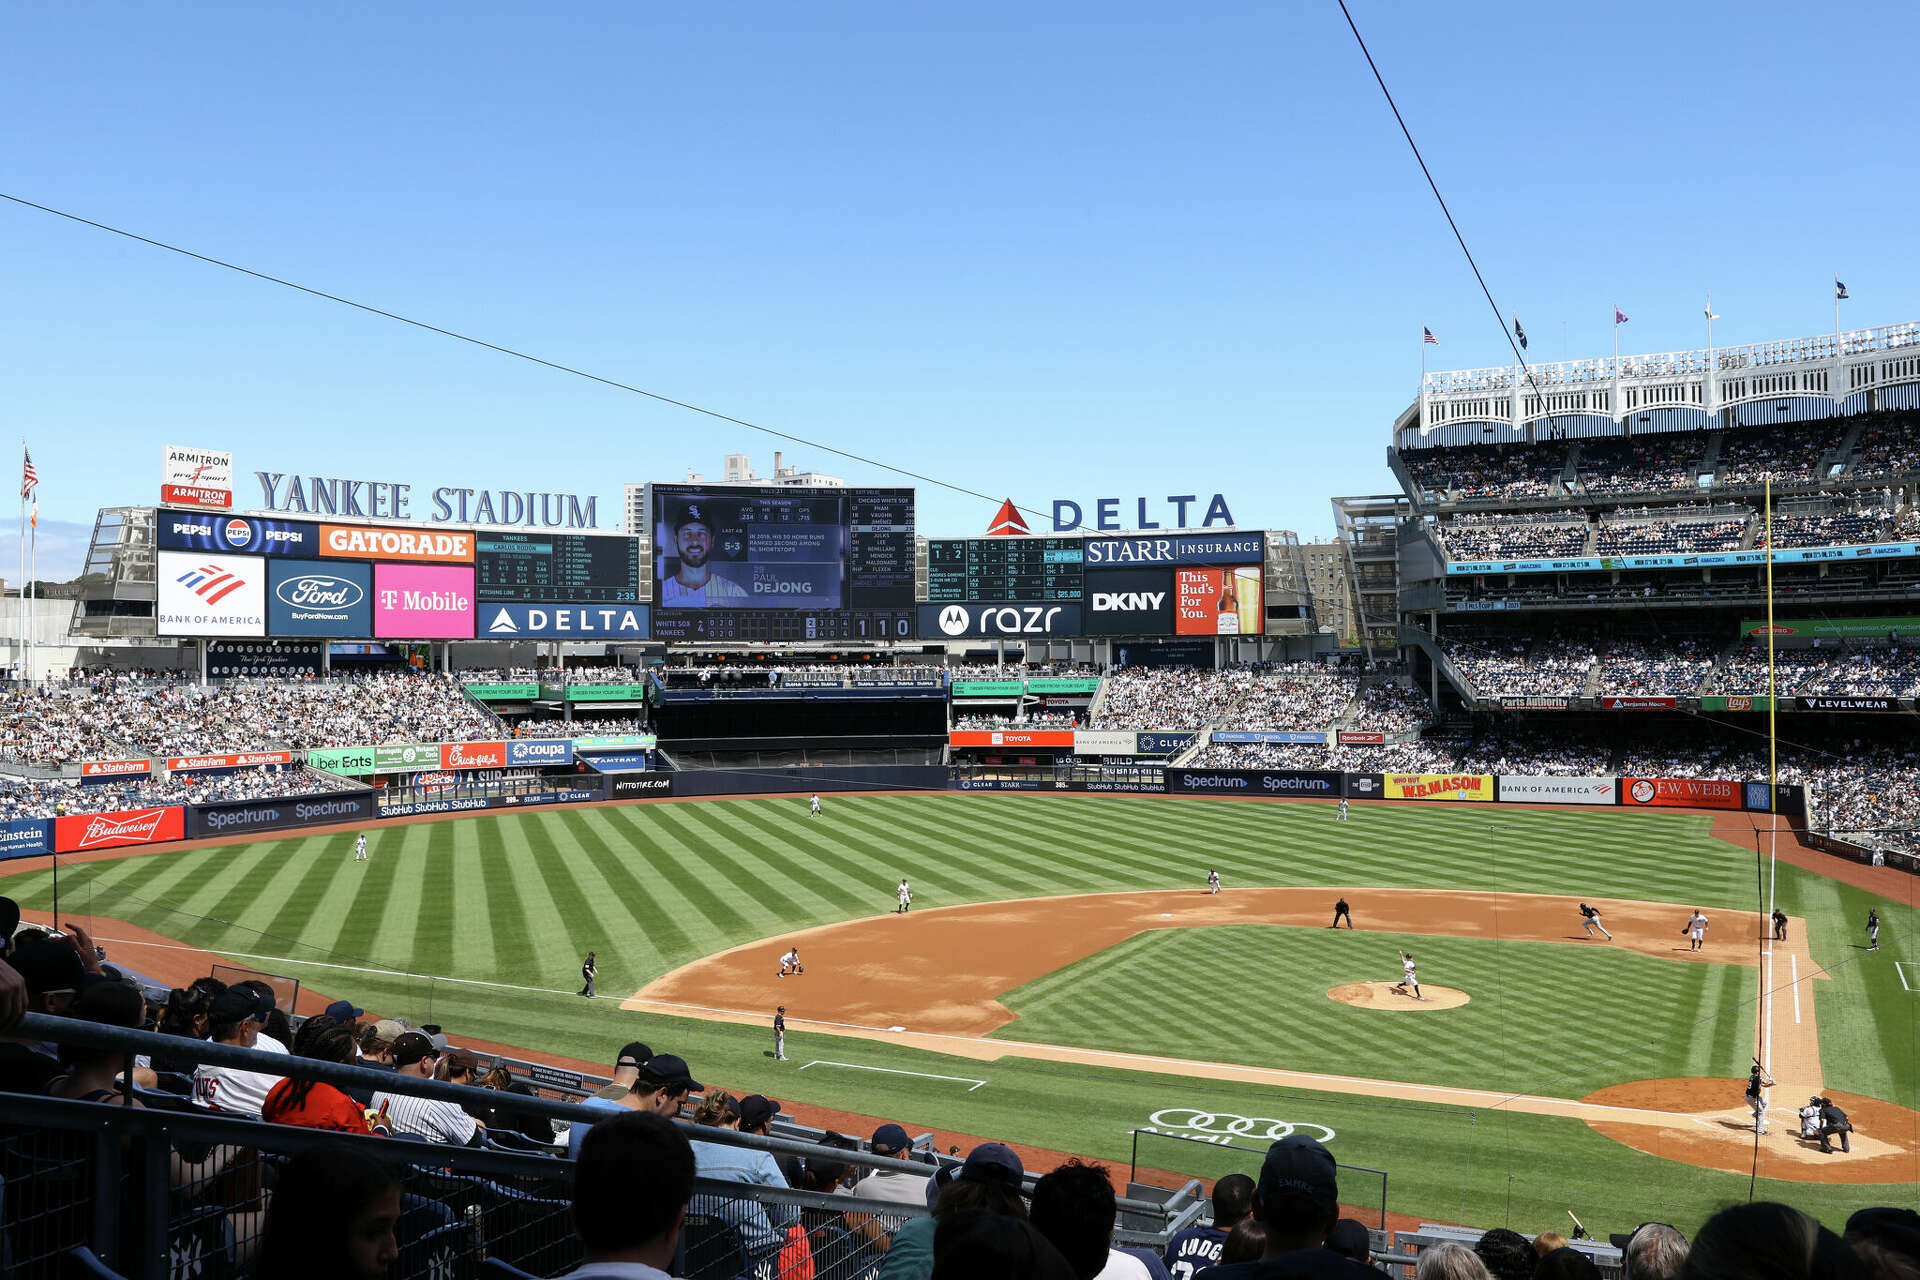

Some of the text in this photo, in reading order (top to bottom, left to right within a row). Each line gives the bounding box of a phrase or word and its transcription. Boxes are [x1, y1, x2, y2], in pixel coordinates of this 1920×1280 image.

[170, 452, 228, 466] ARMITRON
[172, 488, 226, 500] ARMITRON
[254, 471, 598, 529] YANKEE STADIUM
[1052, 494, 1234, 532] DELTA
[173, 522, 212, 536] PEPSI
[226, 528, 250, 537] PEPSI
[266, 530, 303, 542] PEPSI
[328, 530, 466, 556] GATORADE
[724, 542, 740, 550] 5-3
[1181, 540, 1260, 554] INSURANCE
[955, 550, 961, 559] 2
[1087, 539, 1174, 563] STARR
[1180, 571, 1208, 583] This
[292, 580, 348, 606] Ford
[753, 582, 812, 593] DEJONG
[1180, 582, 1215, 594] Bud's
[403, 591, 468, 612] Mobile
[616, 592, 635, 600] 2:35
[1092, 591, 1166, 612] DKNY
[1180, 596, 1202, 607] For
[160, 615, 262, 625] BANK OF AMERICA
[291, 612, 348, 622] BuyFordNow.com
[528, 609, 640, 631] DELTA
[980, 606, 1062, 632] razr
[1180, 607, 1208, 619] You.
[859, 620, 865, 636] 1
[880, 620, 886, 636] 1
[897, 620, 908, 636] 0
[1502, 697, 1568, 707] Parts Authority
[529, 745, 565, 757] coupa
[311, 756, 372, 770] Uber Eats
[616, 779, 670, 790] NITTOTIRE.COM
[1184, 774, 1244, 789] Spectrum
[1263, 776, 1326, 791] Spectrum
[1657, 782, 1731, 796] F.W. WEBB
[295, 801, 356, 820] Spectrum
[415, 802, 448, 813] StubHub
[452, 799, 486, 809] StubHub
[381, 806, 413, 817] StubHub
[207, 808, 275, 830] Spectrum
[88, 820, 156, 838] Budweiser
[1178, 1238, 1224, 1261] JUDG
